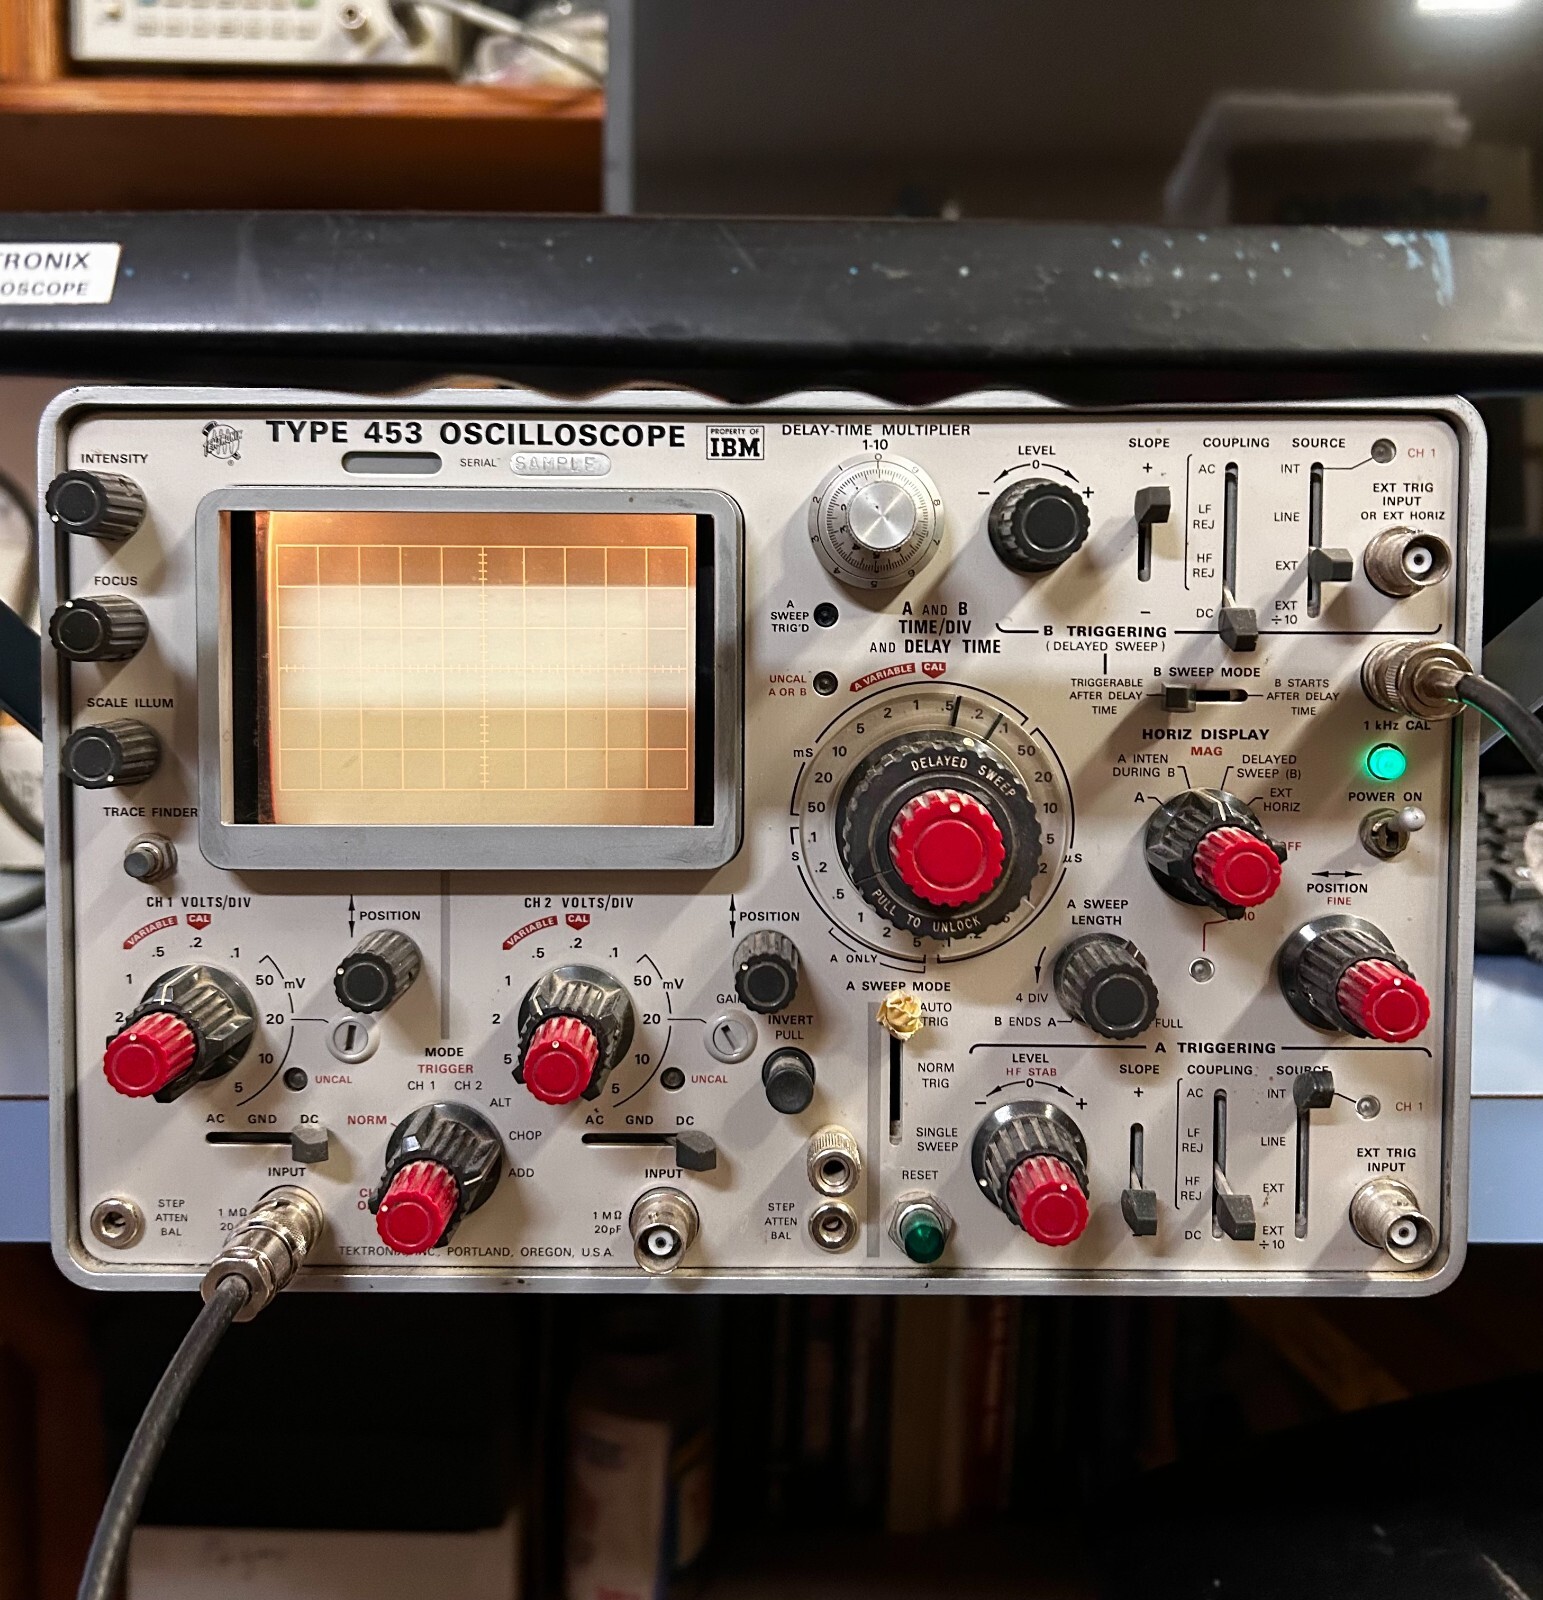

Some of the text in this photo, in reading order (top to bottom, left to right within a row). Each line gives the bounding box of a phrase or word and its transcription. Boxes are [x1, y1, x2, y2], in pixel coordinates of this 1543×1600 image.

[0, 252, 90, 270] RONIX
[266, 421, 685, 447] TYPE 453 OSCILLOSCOPE
[782, 425, 970, 436] DELAY-TIME MULTIPLIER
[710, 437, 760, 457] IBM
[862, 440, 888, 450] 1-10
[1129, 438, 1170, 448] SLOPE
[1203, 438, 1270, 448] COUPLING
[1292, 438, 1346, 448] SOURCE
[1018, 446, 1056, 456] LEVEL
[81, 453, 148, 464] INTENSITY
[515, 456, 596, 472] SAMPLE
[1198, 465, 1216, 473] AC
[1281, 465, 1300, 473] INT
[1373, 483, 1433, 492] EXT TRIG
[1383, 497, 1421, 506] INPUT
[1274, 513, 1300, 521] LINE
[1383, 511, 1445, 520] EXT HORIZ
[1193, 520, 1214, 529] REJ
[1197, 554, 1212, 562] HF
[1276, 561, 1298, 570] EXT
[1193, 569, 1214, 578] REJ
[94, 576, 138, 586] FOCUS
[923, 604, 947, 615] AND
[1275, 601, 1297, 610] EXT
[771, 612, 809, 620] SWEEP
[1197, 609, 1213, 618] DC
[899, 620, 971, 636] TIME/DIV
[1067, 626, 1167, 637] TRIGGERING
[870, 640, 1001, 653] AND DELAY TIME
[923, 663, 945, 671] CAL
[863, 664, 913, 685] VARIABLE
[1169, 667, 1260, 677] SWEEP MODE
[770, 675, 807, 683] UNCAL
[1071, 679, 1143, 687] TRIGGERABLE
[1288, 679, 1329, 688] STARTS
[1070, 691, 1142, 700] AFTER DELAY
[1267, 692, 1340, 700] AFTER DELAY
[87, 698, 174, 708] SCALE ILLUM
[1092, 706, 1117, 714] TIME
[1291, 707, 1316, 715] TIME
[1376, 721, 1431, 730] kHz CAL
[1143, 729, 1269, 740] HORIZ DISPLAY
[1017, 746, 1035, 756] 50
[1191, 747, 1222, 756] MAG
[1133, 755, 1168, 764] INTEN
[1242, 755, 1297, 764] DELAYED
[911, 755, 1016, 796] DELAYED SWEEP
[1035, 772, 1052, 782] 20
[1113, 768, 1161, 777] DURING
[1237, 769, 1279, 778] SWEEP
[815, 773, 832, 783] 20
[1270, 789, 1292, 797] EXT
[1349, 792, 1422, 801] POWER ON
[808, 802, 825, 813] 50
[1263, 802, 1300, 812] HORIZ
[103, 807, 198, 818] TRACE FINDER
[1307, 883, 1368, 893] POSITION
[182, 896, 251, 910] VOLTS/DIV
[562, 895, 634, 911] VOLTS/DIV
[1084, 900, 1128, 909] SWEEP
[1327, 897, 1351, 905] FINE
[359, 911, 421, 920] POSITION
[872, 889, 982, 933] PULL TO UNLOCK
[188, 915, 209, 923] CAL
[568, 915, 589, 923] CAL
[740, 912, 799, 922] POSITION
[1072, 916, 1121, 925] LENGTH
[127, 917, 174, 945] VARIABLE
[507, 918, 555, 946] VARIABLE
[846, 955, 877, 963] ONLY
[256, 975, 274, 985] 50
[285, 978, 305, 988] mV
[634, 976, 652, 986] 50
[663, 979, 684, 989] mV
[862, 981, 951, 991] SWEEP MODE
[716, 993, 739, 1004] GAI
[920, 1002, 952, 1012] AUTO
[266, 1014, 284, 1024] 20
[643, 1014, 660, 1024] 20
[768, 1015, 812, 1025] INVERT
[922, 1016, 949, 1027] TRIG
[1009, 1017, 1041, 1027] ENDS
[1155, 1019, 1183, 1028] FULL
[775, 1031, 803, 1040] PULL
[425, 1048, 464, 1056] MODE
[1178, 1043, 1276, 1054] TRIGGERING
[1012, 1054, 1049, 1063] LEVEL
[418, 1064, 473, 1074] TRIGGER
[918, 1063, 954, 1072] NORM
[1029, 1068, 1057, 1076] STAB
[1120, 1065, 1160, 1074] SLOPE
[1187, 1065, 1252, 1075] COUPLING
[315, 1075, 352, 1084] UNCAL
[691, 1075, 728, 1083] UNCAL
[922, 1078, 949, 1088] TRIG
[1187, 1089, 1203, 1097] AC
[1267, 1090, 1286, 1098] INT
[490, 1098, 511, 1107] ALT
[206, 1115, 225, 1123] AC
[248, 1115, 277, 1123] GND
[347, 1116, 387, 1124] NORM
[585, 1116, 604, 1124] AC
[626, 1116, 653, 1124] GND
[509, 1131, 542, 1140] CHOP
[916, 1128, 958, 1138] SINGLE
[1261, 1137, 1286, 1146] LINE
[917, 1142, 958, 1152] SWEEP
[1182, 1143, 1203, 1152] REJ
[1357, 1148, 1416, 1157] EXT TRIG
[1367, 1163, 1405, 1171] INPUT
[268, 1168, 306, 1176] INPUT
[508, 1168, 534, 1178] ADD
[645, 1169, 683, 1178] INPUT
[902, 1170, 938, 1180] RESET
[1263, 1184, 1285, 1192] EXT
[1181, 1191, 1201, 1200] REJ
[768, 1203, 795, 1211] STEP
[155, 1214, 188, 1222] ATTEN
[765, 1217, 797, 1225] ATTEN
[595, 1225, 621, 1235] 20pF
[1262, 1226, 1284, 1235] EXT
[1185, 1231, 1201, 1239] DC
[448, 1248, 514, 1258] PORTLAND,
[521, 1248, 574, 1258] OREGON,
